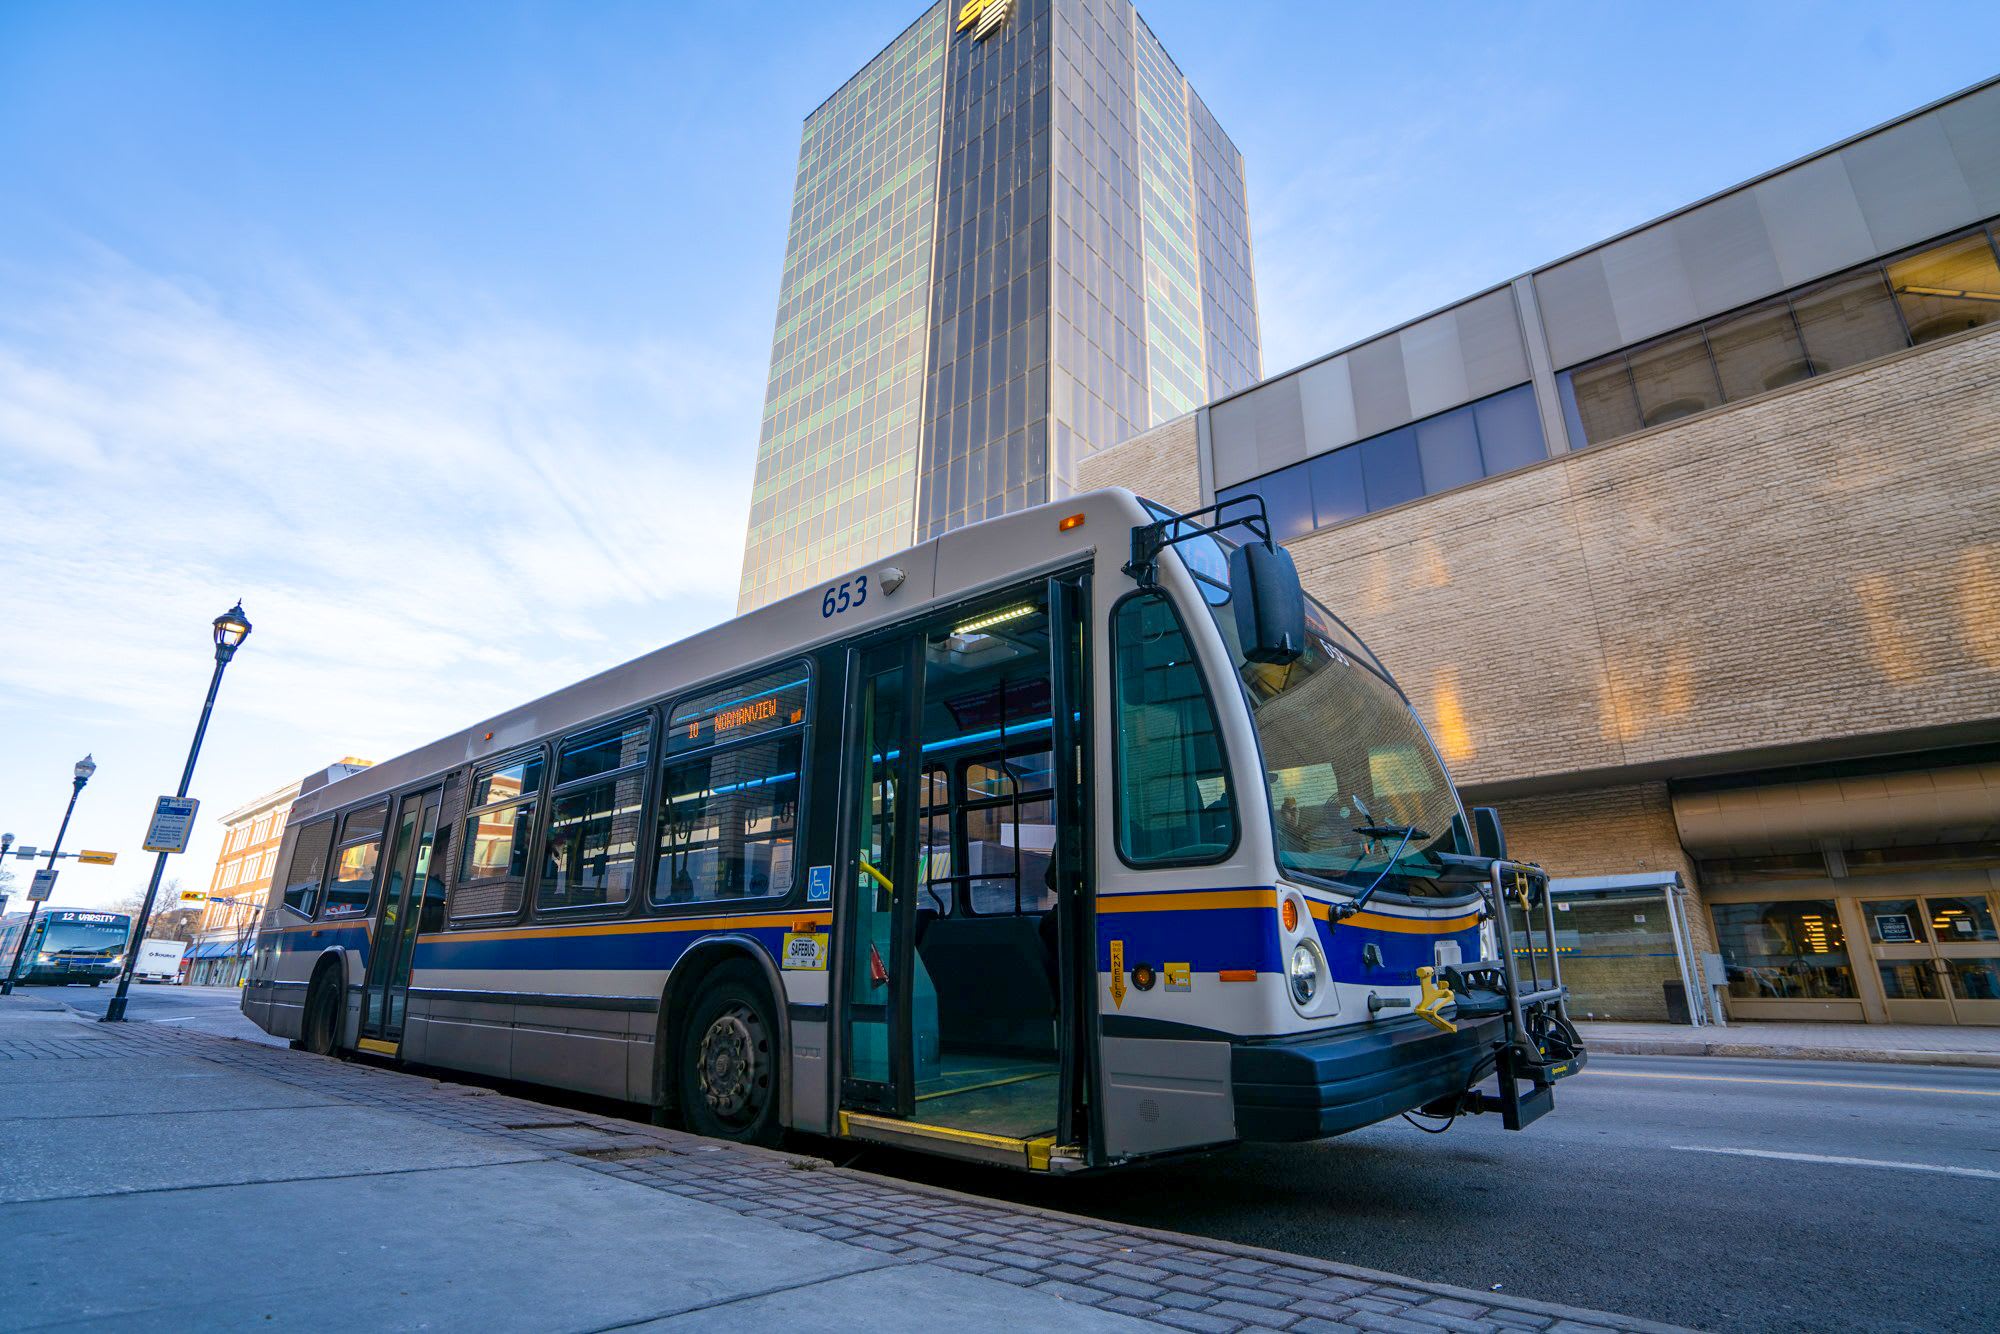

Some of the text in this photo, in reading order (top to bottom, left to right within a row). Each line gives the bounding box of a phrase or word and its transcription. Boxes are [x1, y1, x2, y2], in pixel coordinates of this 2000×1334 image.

[821, 575, 868, 619] 653
[1319, 638, 1350, 667] 653
[688, 698, 777, 739] 10 NORMANVIEW
[61, 912, 116, 923] 12 VARSITY
[791, 942, 816, 957] SAFEBUS
[1113, 953, 1122, 998] KNEELS
